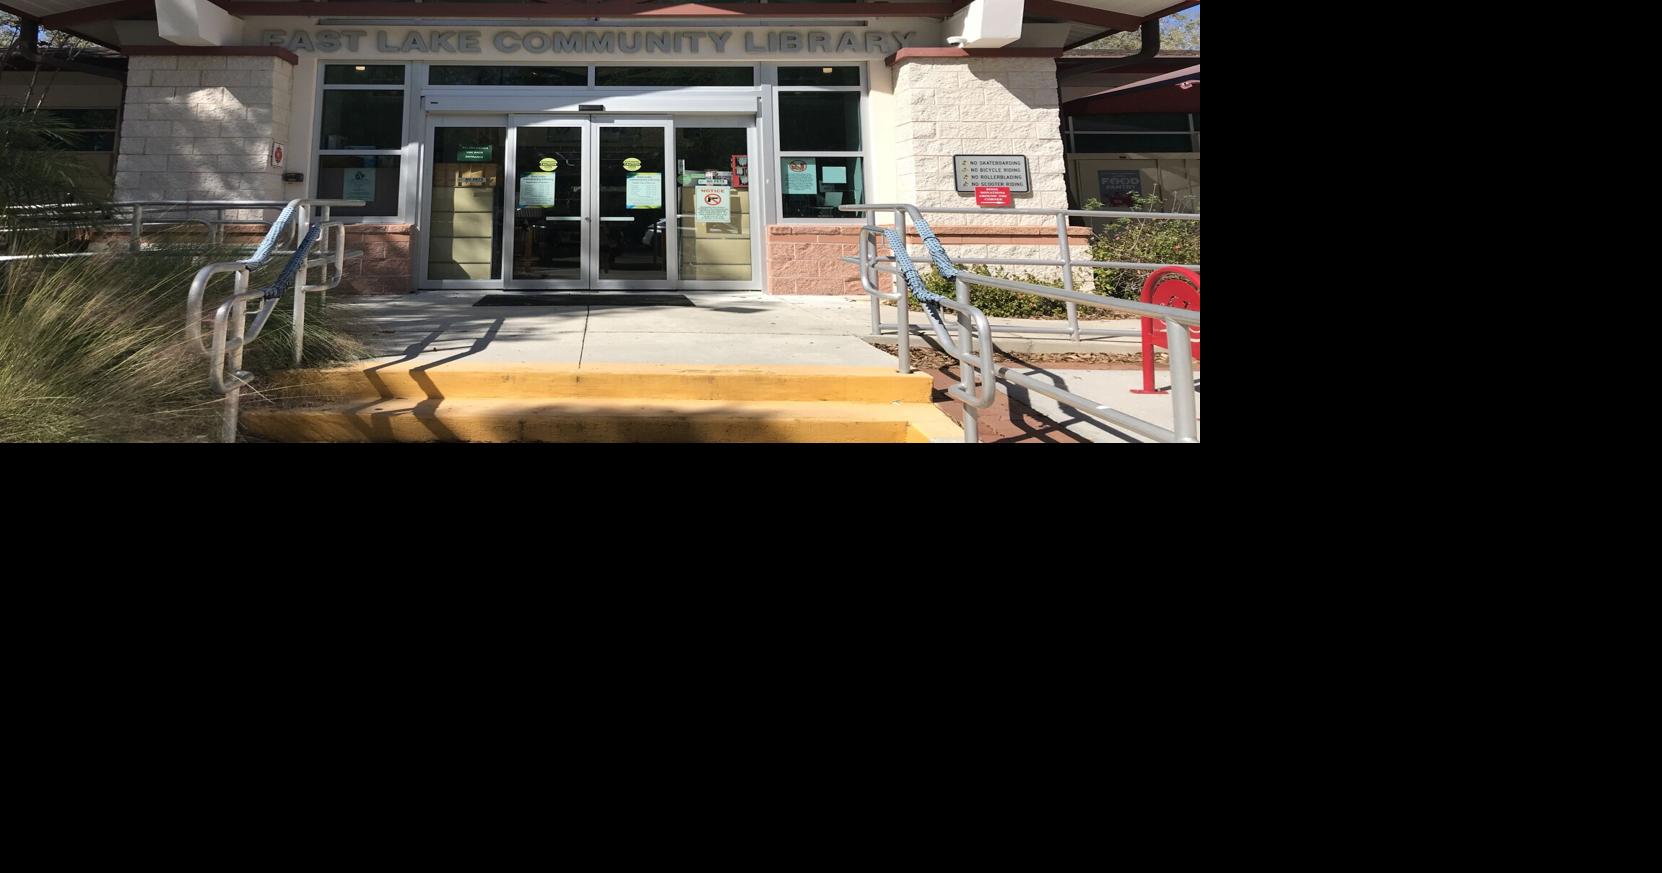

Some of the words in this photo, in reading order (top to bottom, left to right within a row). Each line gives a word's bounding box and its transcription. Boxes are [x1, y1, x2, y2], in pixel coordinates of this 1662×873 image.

[262, 30, 368, 53] EAST
[376, 30, 483, 53] LAKE
[492, 30, 732, 55] COMMUNITY
[744, 31, 917, 55] LIBRARY
[1101, 177, 1140, 185] FOOD
